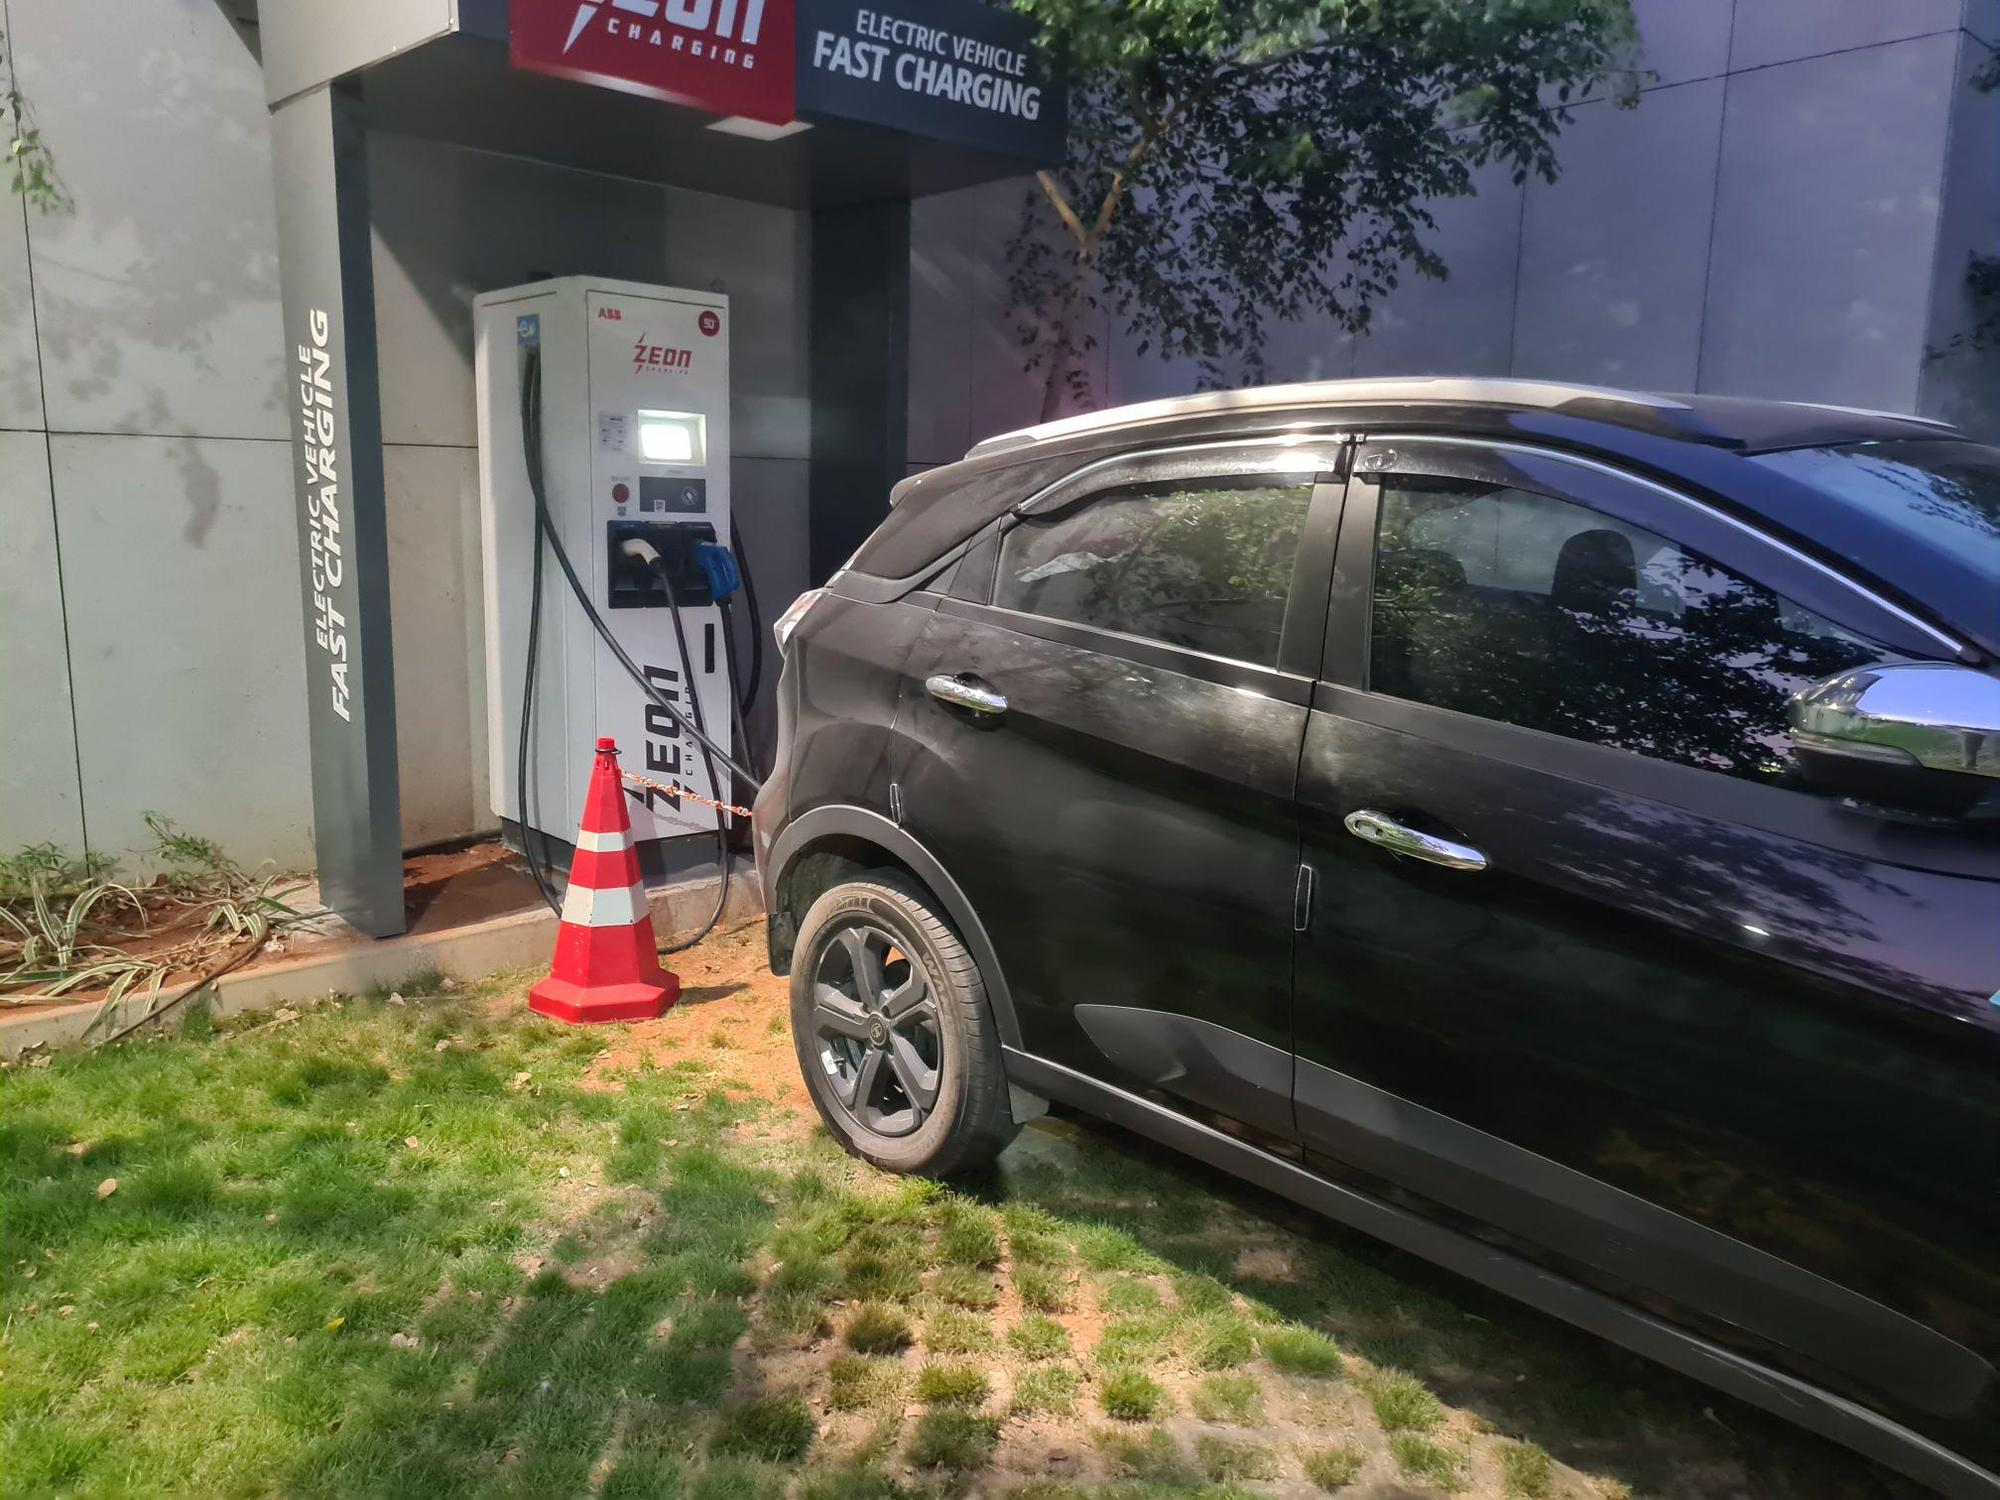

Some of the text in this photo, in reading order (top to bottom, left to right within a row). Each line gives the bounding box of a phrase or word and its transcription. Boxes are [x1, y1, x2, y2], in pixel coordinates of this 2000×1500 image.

[607, 17, 755, 69] CHARGING
[813, 31, 1041, 121] FAST CHARGING
[856, 9, 1028, 78] ELECTRIC VEHICLE
[598, 307, 621, 321] ABB
[633, 344, 692, 368] ZEON
[298, 344, 329, 650] ELECTRIC VEHICLE
[310, 309, 351, 722] FAST CHARGING
